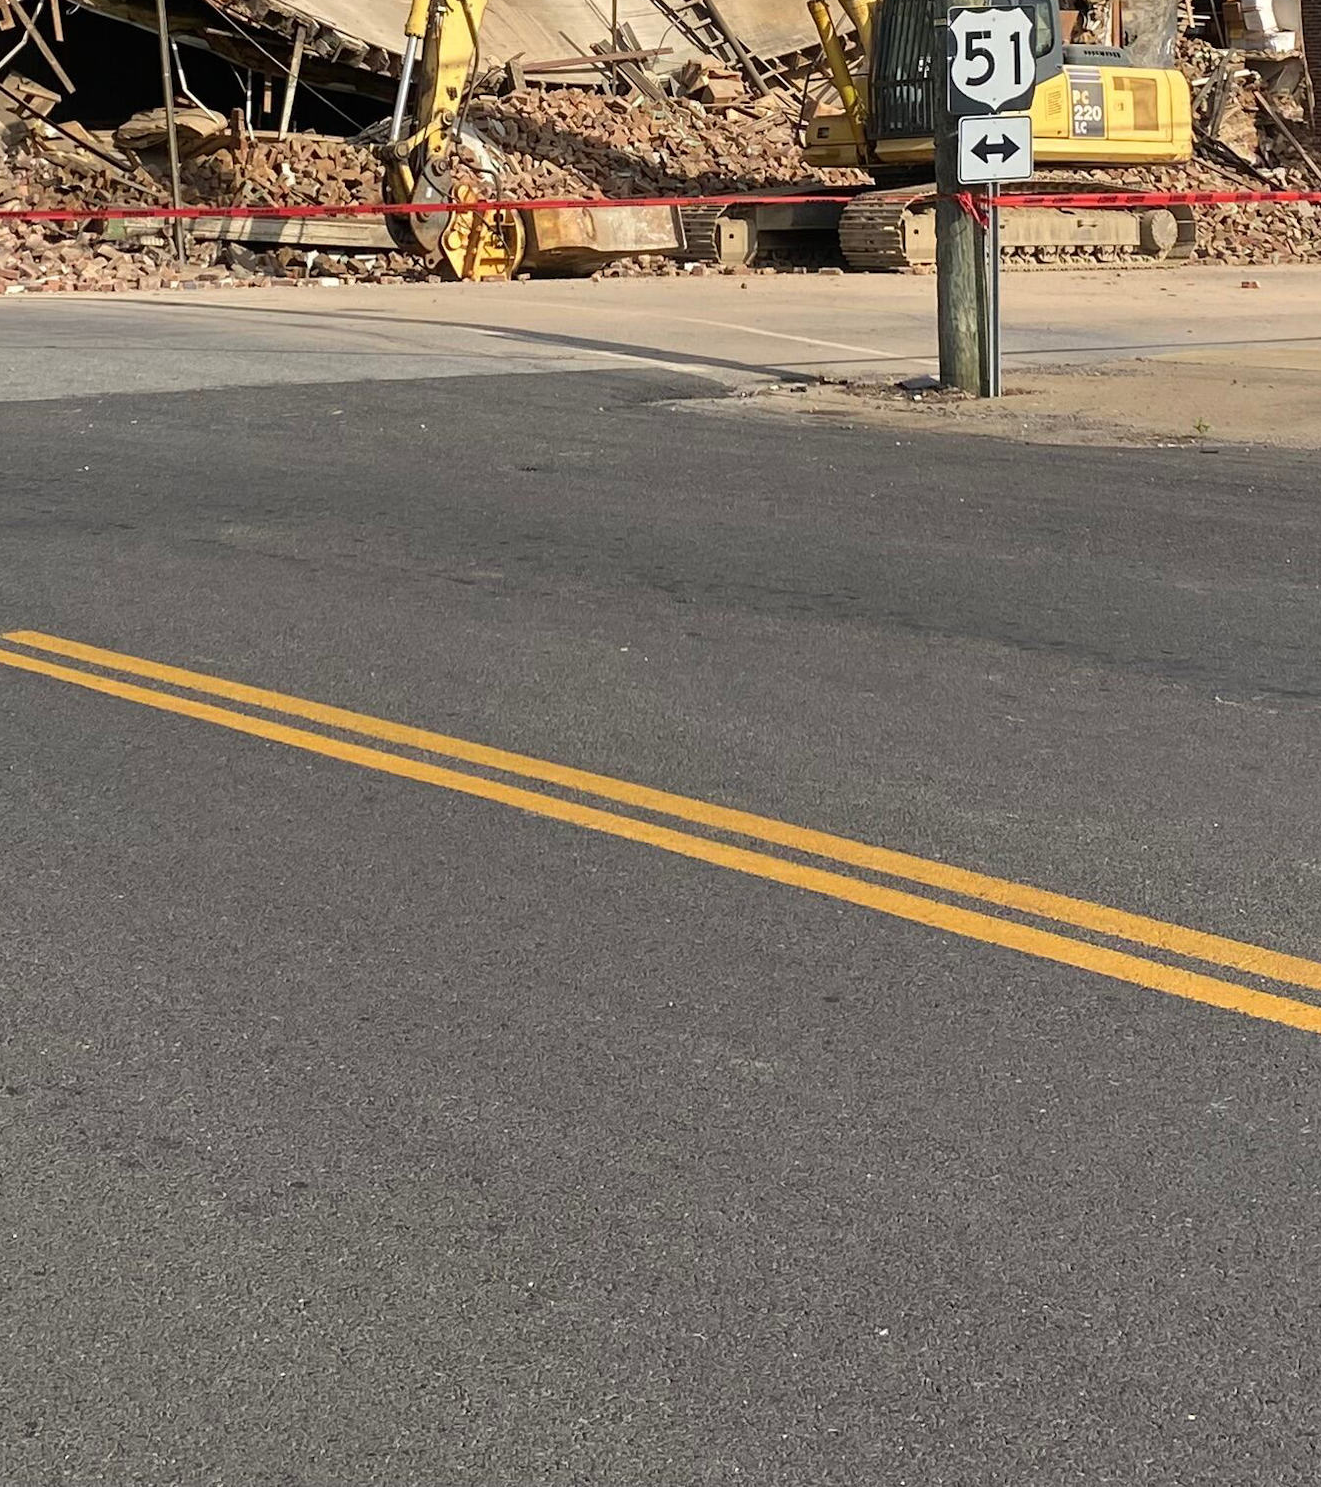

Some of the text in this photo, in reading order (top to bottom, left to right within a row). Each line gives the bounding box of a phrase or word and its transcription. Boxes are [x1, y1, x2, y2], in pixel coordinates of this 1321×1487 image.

[964, 30, 1022, 87] 51
[1072, 90, 1090, 105] PC
[1073, 105, 1103, 121] 220
[1074, 121, 1088, 134] LC
